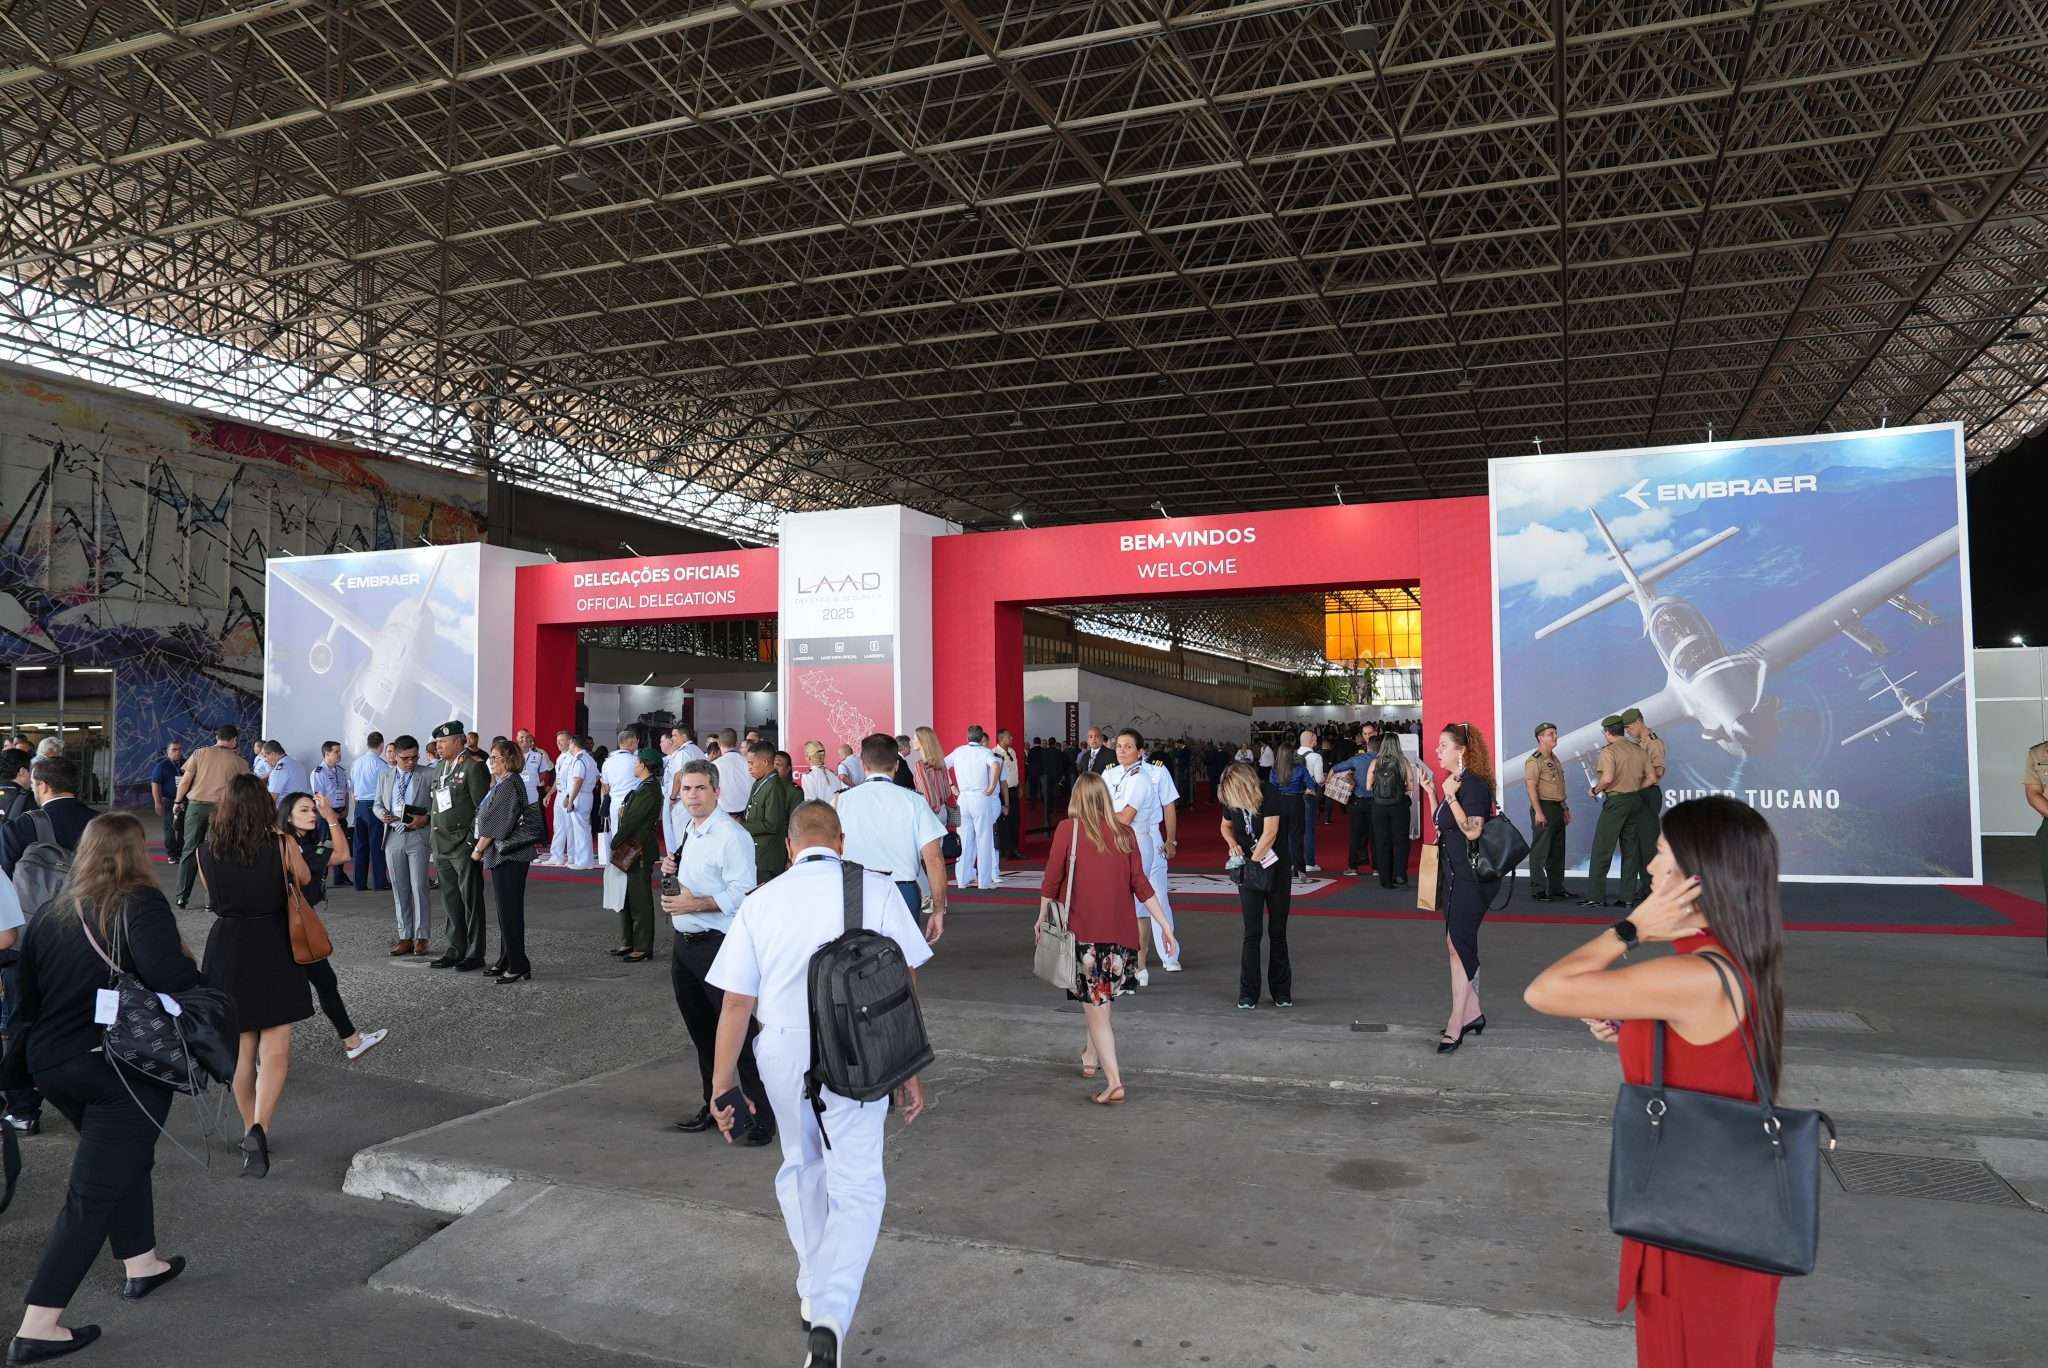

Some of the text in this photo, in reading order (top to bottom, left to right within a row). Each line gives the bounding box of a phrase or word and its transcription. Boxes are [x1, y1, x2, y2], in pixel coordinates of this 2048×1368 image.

[1657, 474, 1817, 502] EMBRAER
[1119, 527, 1257, 552] BEM-VINDOS
[573, 564, 741, 588] DELEGAÇÕES OFICIAIS
[1137, 558, 1238, 578] WELCOME
[346, 573, 420, 589] EMBRAER
[797, 572, 881, 593] LAAD
[576, 590, 736, 612] OFFICIAL DELEGATIONS
[821, 607, 855, 621] 2025
[1744, 788, 1840, 809] TUCANO
